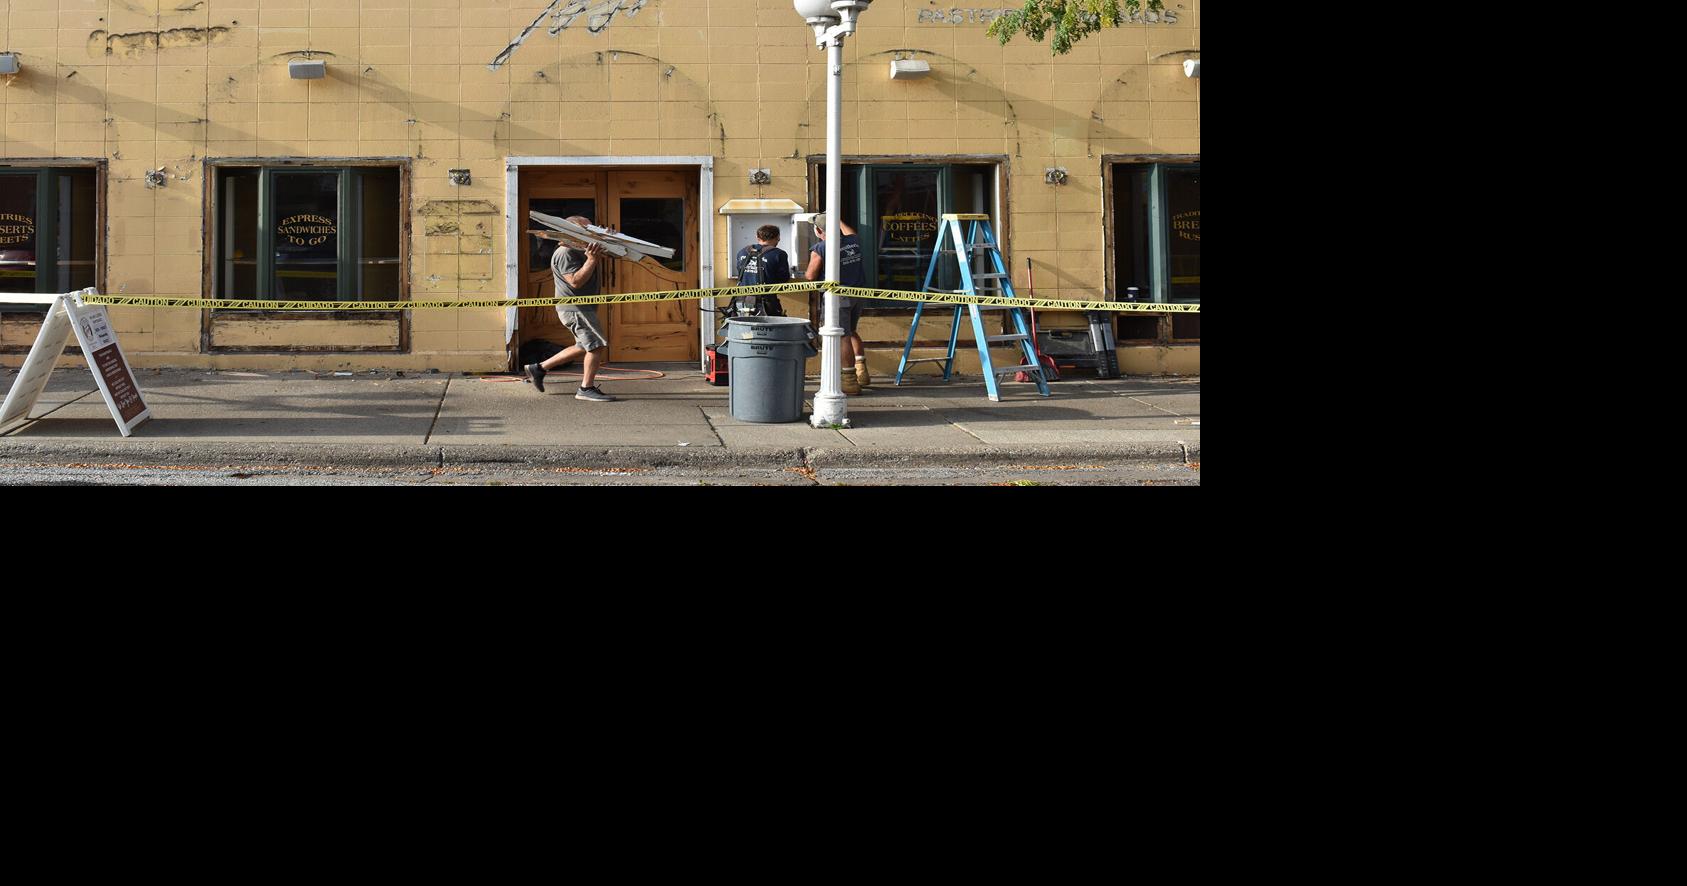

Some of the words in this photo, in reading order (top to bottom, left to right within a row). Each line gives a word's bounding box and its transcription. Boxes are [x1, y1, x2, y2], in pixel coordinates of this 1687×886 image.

[282, 214, 332, 225] EXPRESS
[1173, 220, 1200, 229] BRE
[0, 225, 35, 233] SERTS
[278, 225, 336, 234] SANDWICHES
[882, 222, 937, 231] COFFEES
[288, 235, 305, 246] TO
[308, 235, 327, 246] GO
[133, 298, 169, 306] CAUTION
[242, 301, 279, 309] CAUTION
[462, 300, 499, 308] CAUTION
[516, 298, 553, 306] CUIDADO
[571, 296, 607, 304] CAUTION
[624, 293, 660, 301] CUIDADO
[677, 289, 713, 298] CAUTION
[730, 286, 766, 295] CUIDADO
[782, 282, 817, 291] CAUTION
[840, 288, 874, 297] CAUTION
[892, 291, 927, 300] CUIDADO
[943, 294, 979, 303] CAUTION
[995, 298, 1030, 306] CUIDADO
[1047, 300, 1081, 308] CAUTION
